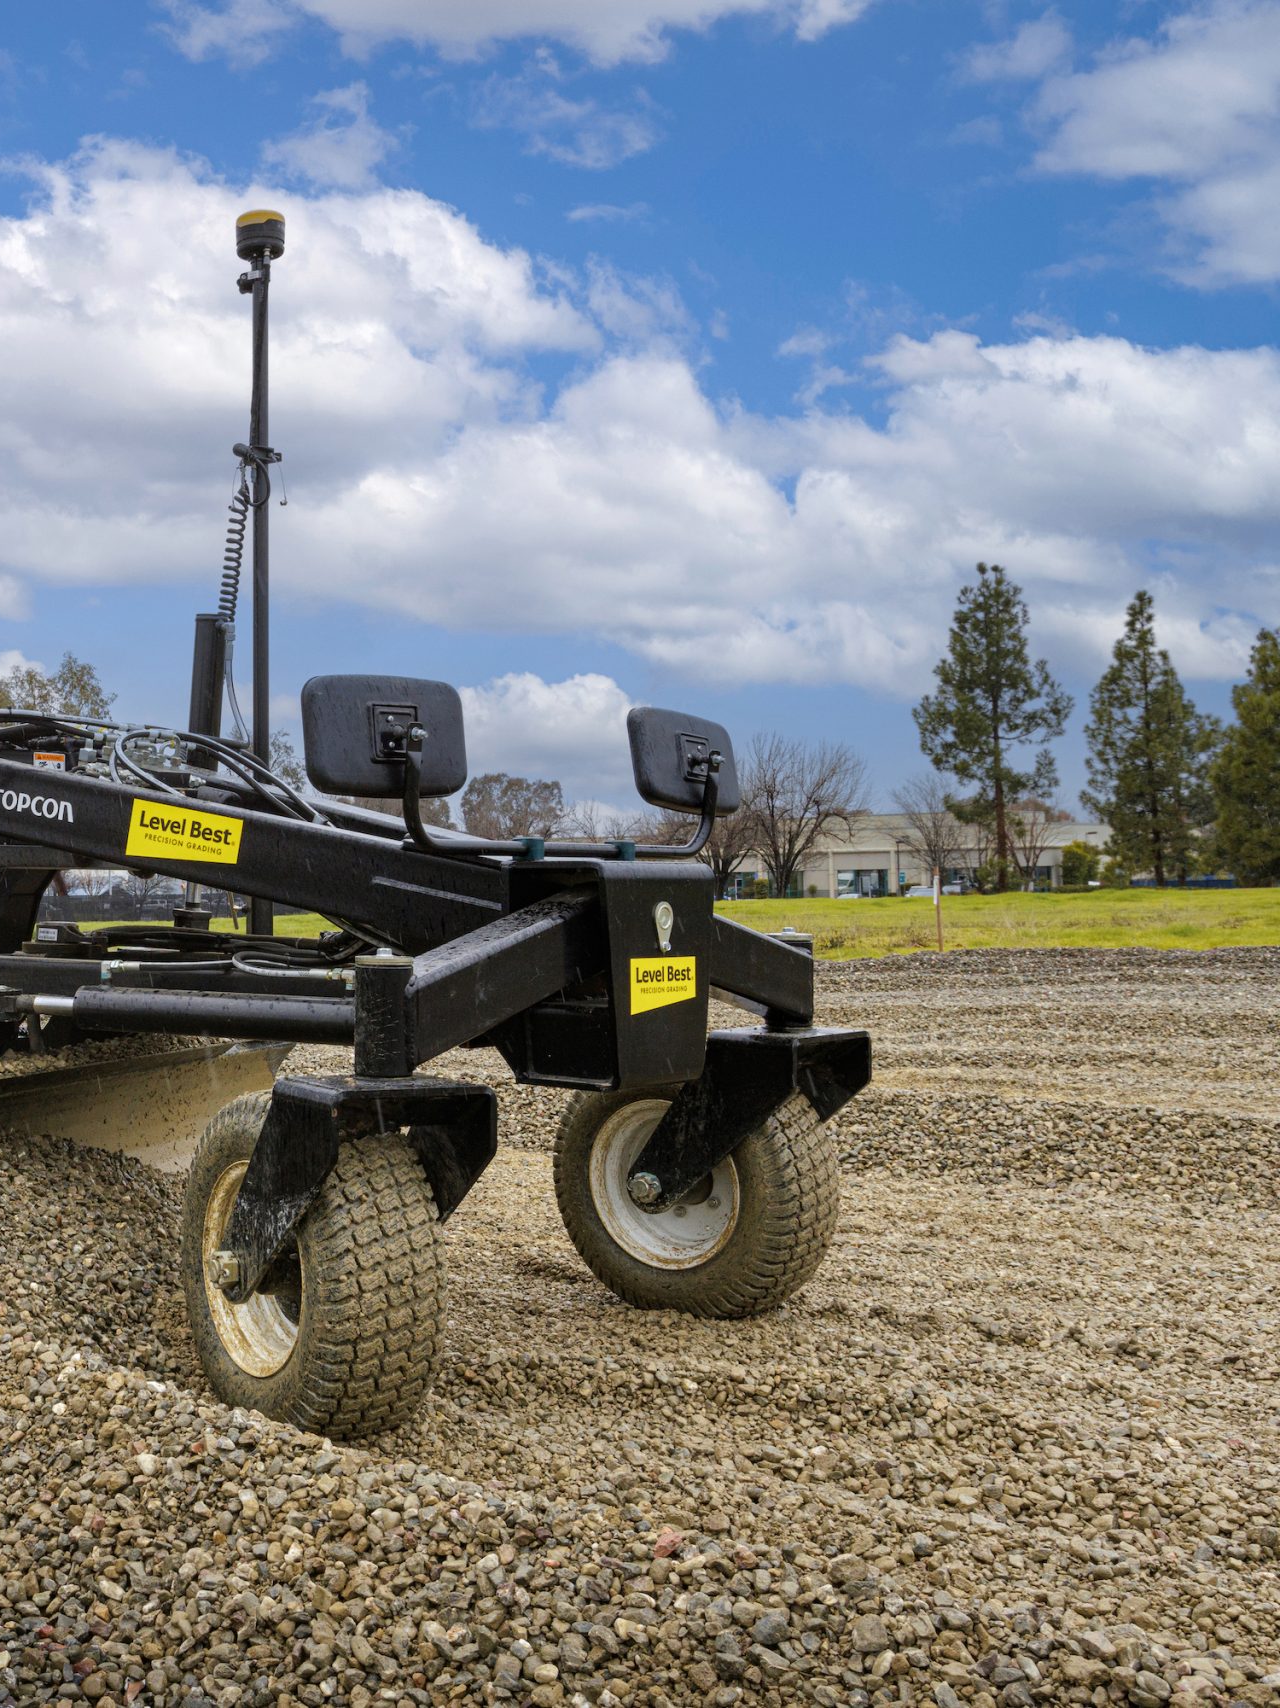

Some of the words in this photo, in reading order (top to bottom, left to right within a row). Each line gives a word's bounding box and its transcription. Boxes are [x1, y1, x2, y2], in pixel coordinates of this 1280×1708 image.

[139, 810, 187, 836] Level
[144, 832, 184, 847] PRECISION
[186, 841, 223, 856] GRADING
[635, 966, 665, 984] Level
[640, 986, 666, 995] PRECISION
[666, 985, 688, 993] GRADING
